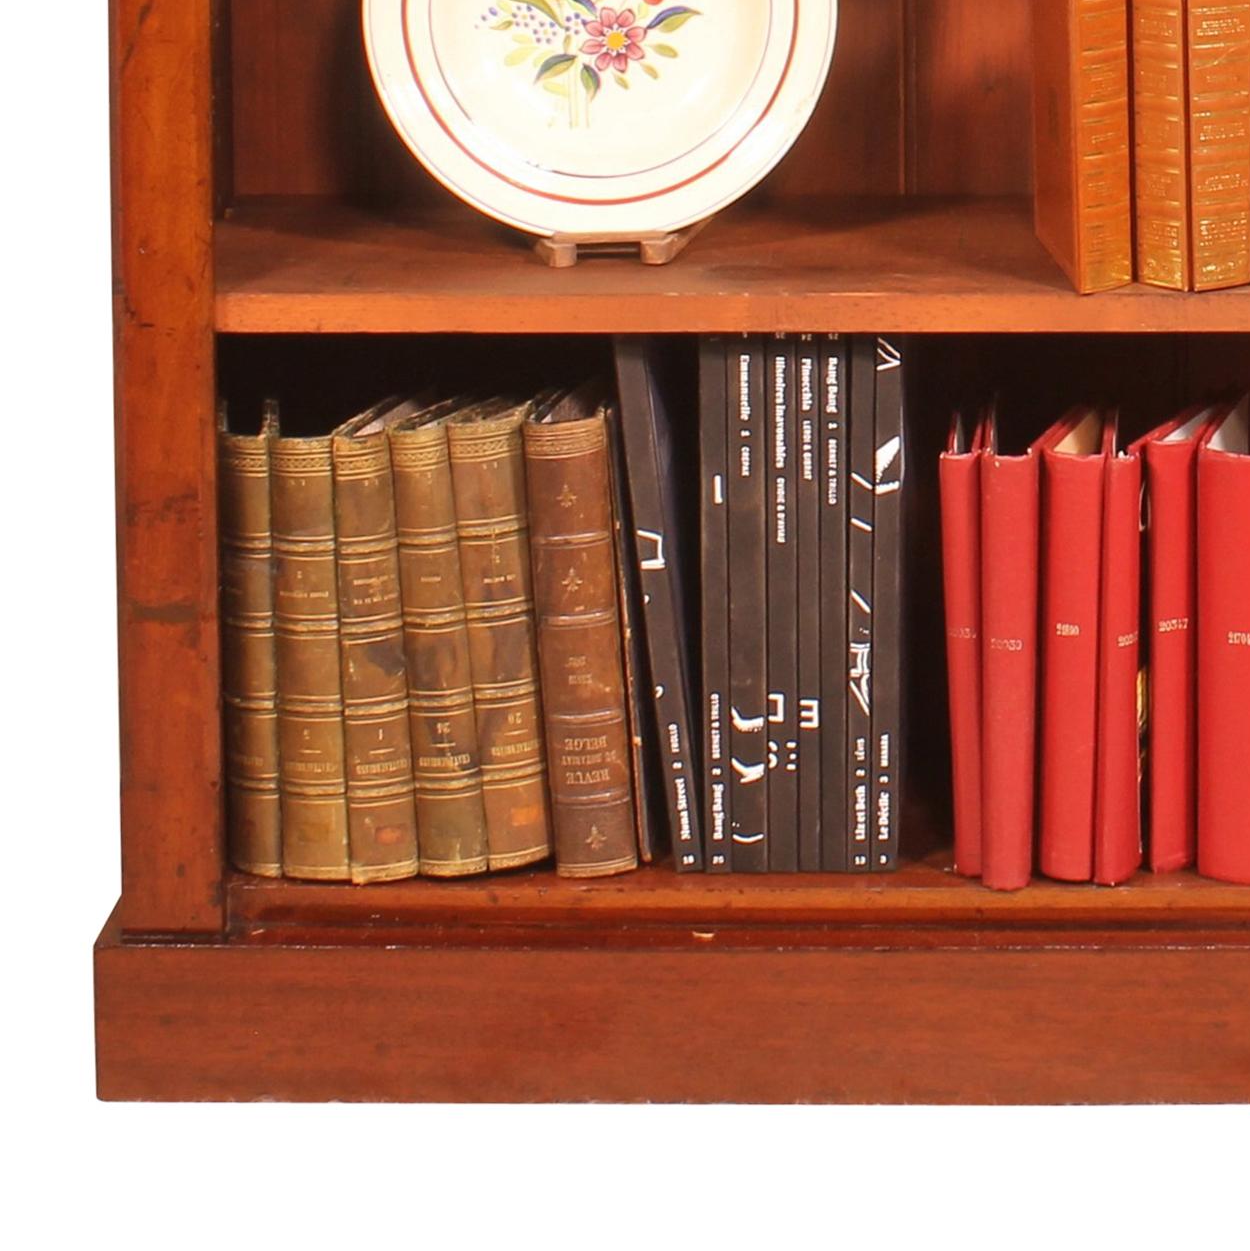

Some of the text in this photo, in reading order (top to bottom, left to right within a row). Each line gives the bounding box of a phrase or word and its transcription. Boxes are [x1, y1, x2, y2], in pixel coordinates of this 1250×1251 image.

[775, 357, 787, 403] Histoires
[826, 357, 839, 384] Bang
[740, 355, 751, 421] Emmanuelle
[826, 385, 839, 413] Bang
[564, 735, 608, 751] BELGE
[566, 769, 610, 785] REVUE
[878, 826, 889, 841] Le
